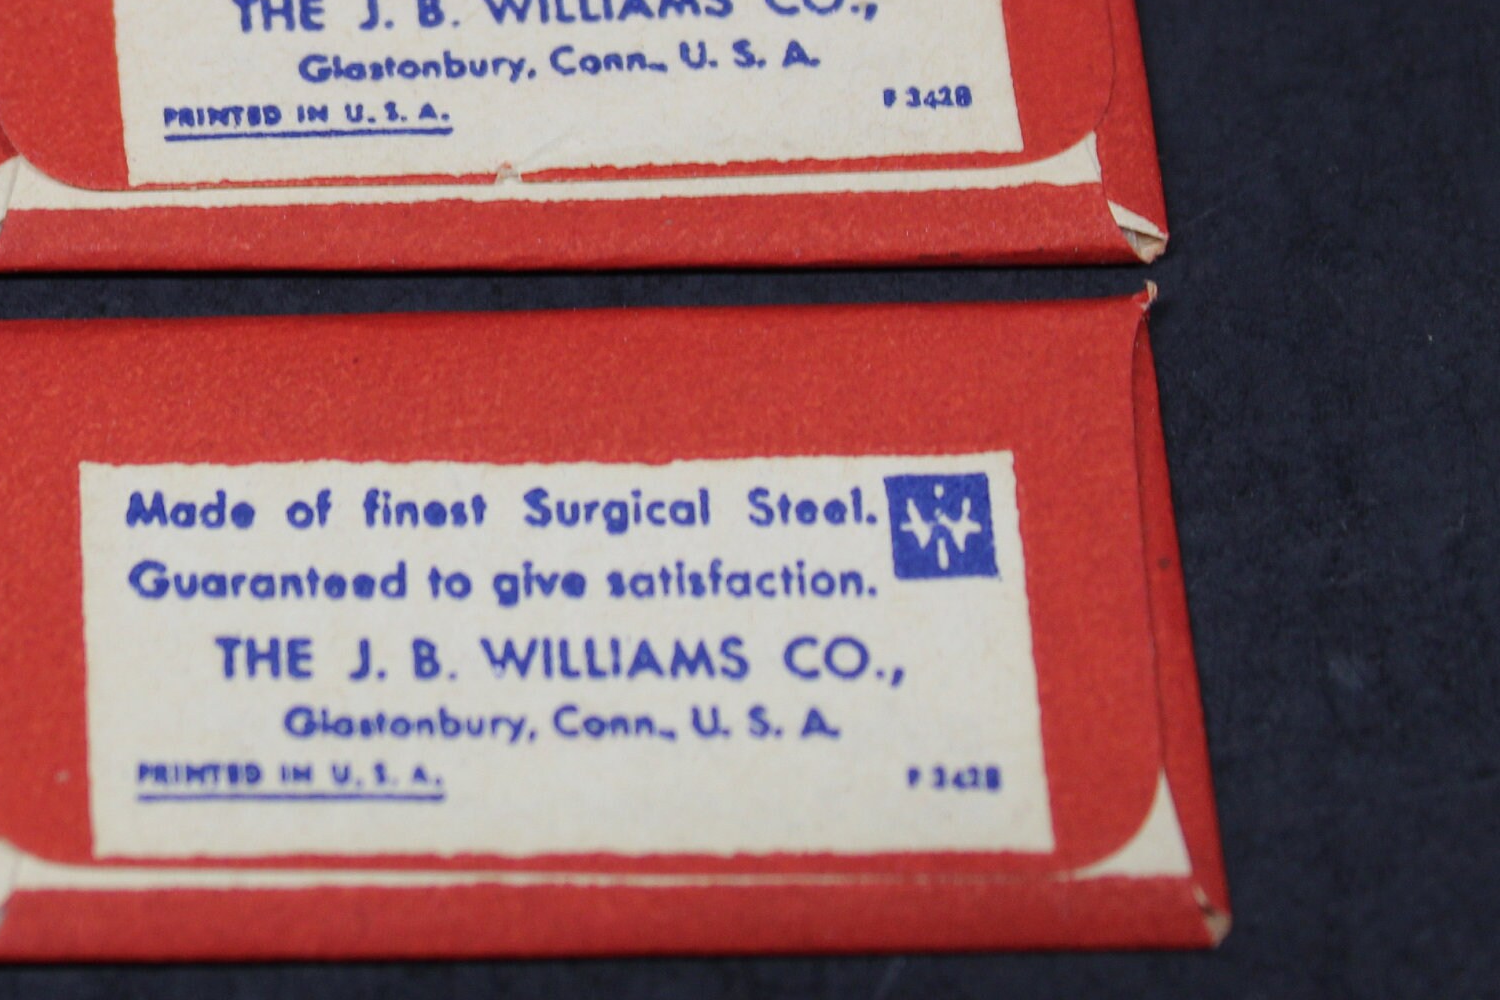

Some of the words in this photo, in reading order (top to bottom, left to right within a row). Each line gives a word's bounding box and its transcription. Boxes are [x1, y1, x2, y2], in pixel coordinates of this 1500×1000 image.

[297, 50, 537, 84] Glastonbury,
[678, 40, 719, 71] U.
[731, 38, 767, 69] S.
[781, 39, 821, 69] A.
[125, 489, 256, 530] Made
[285, 488, 333, 530] of
[362, 487, 488, 528] finest
[523, 486, 711, 536] Surgical
[747, 486, 878, 527] Steel.
[127, 559, 408, 601] Guaranteed
[427, 566, 473, 601] to
[492, 560, 587, 609] give
[606, 557, 877, 599] satisfaction.
[214, 635, 313, 681] THE
[349, 637, 387, 682] J.
[411, 637, 456, 681] B.
[479, 635, 750, 681] WILLIAMS
[782, 635, 905, 688] CO.,
[283, 705, 536, 744] Glastonbury,
[691, 706, 731, 739] U.
[747, 704, 783, 739] S.
[800, 707, 841, 739] A.
